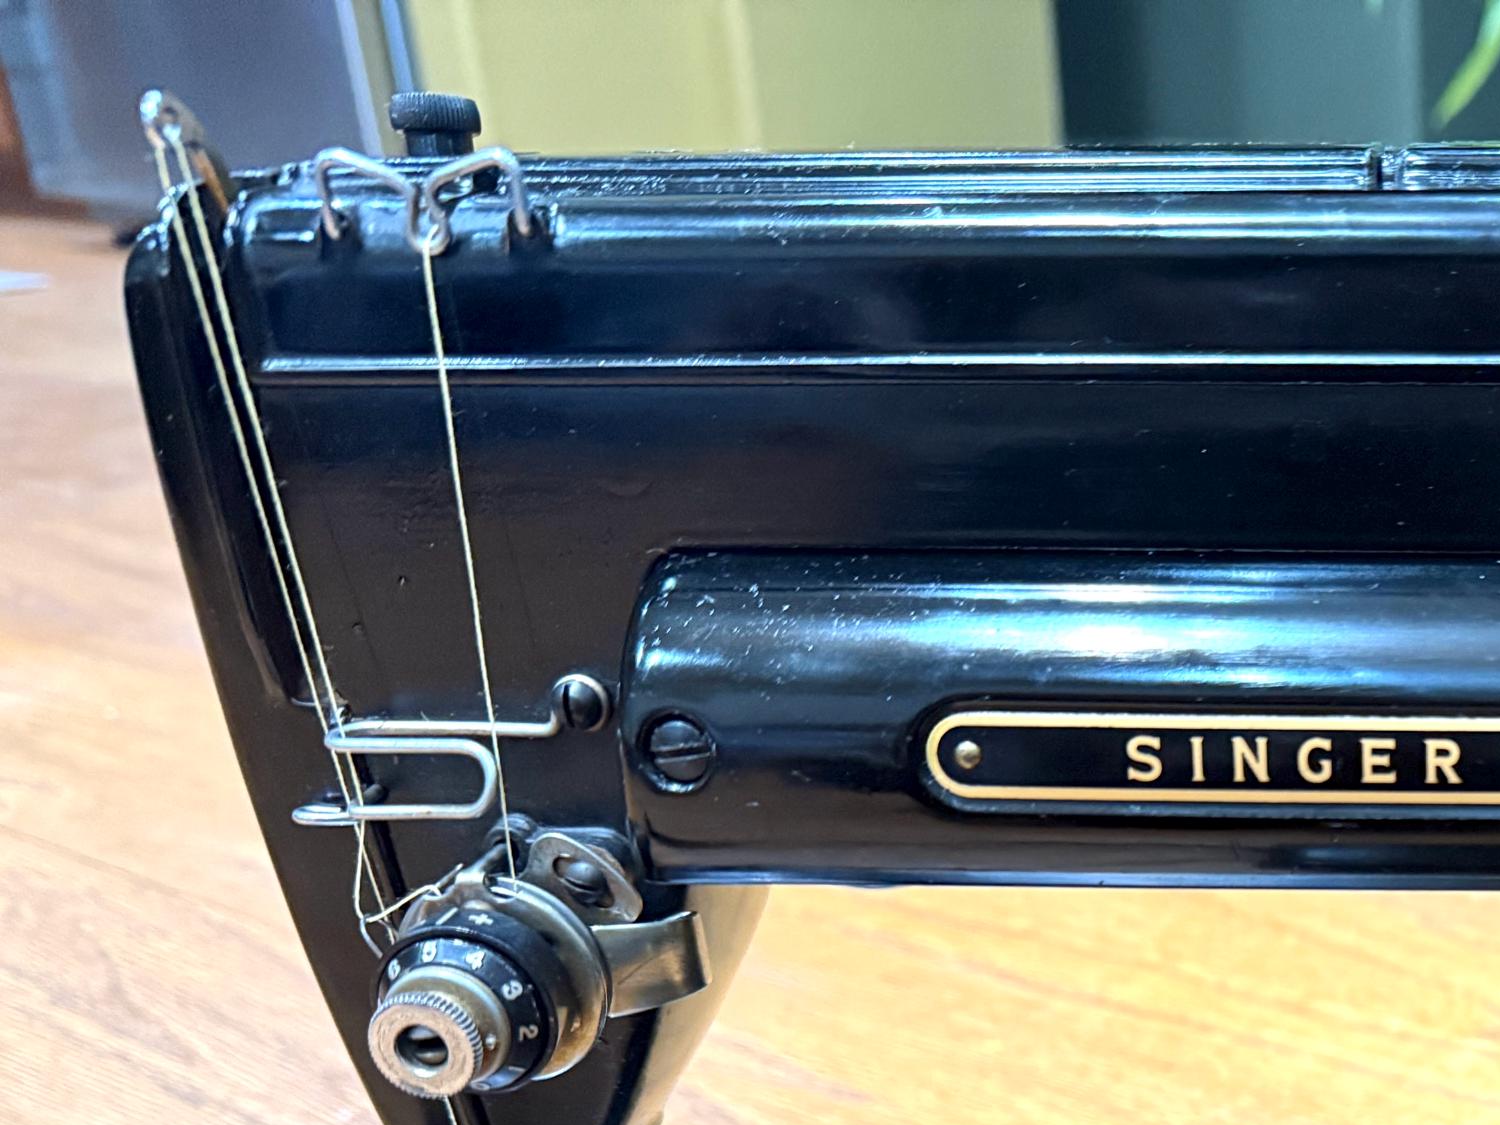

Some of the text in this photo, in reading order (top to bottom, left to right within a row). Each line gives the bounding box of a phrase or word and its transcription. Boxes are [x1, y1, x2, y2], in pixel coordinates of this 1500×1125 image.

[1126, 736, 1462, 785] SINGER
[388, 958, 401, 981] 6
[465, 949, 486, 971] 4
[501, 979, 524, 1001] 3
[518, 1023, 539, 1043] 2
